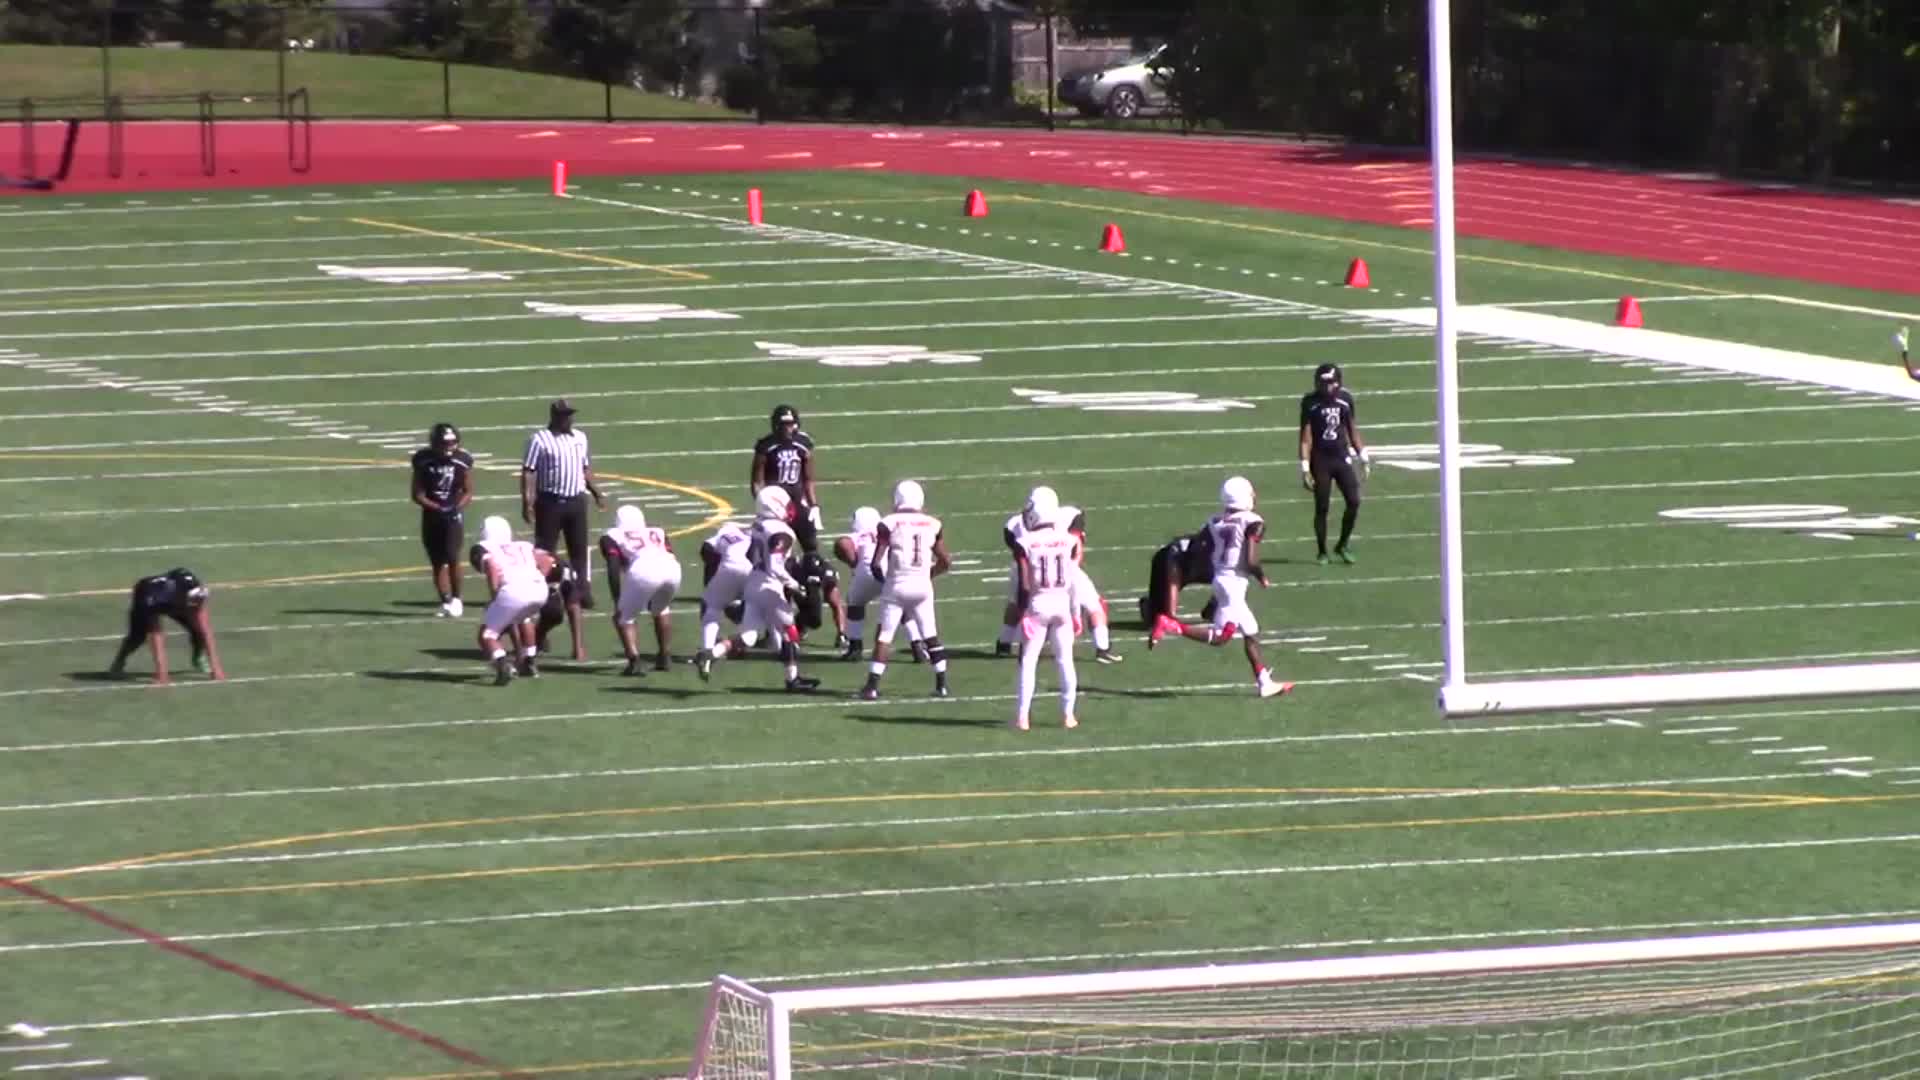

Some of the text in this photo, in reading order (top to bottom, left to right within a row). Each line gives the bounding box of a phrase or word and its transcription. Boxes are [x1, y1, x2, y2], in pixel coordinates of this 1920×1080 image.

[1323, 413, 1338, 441] 2
[778, 460, 801, 484] 10
[911, 533, 923, 567] 1
[1037, 554, 1066, 588] 11
